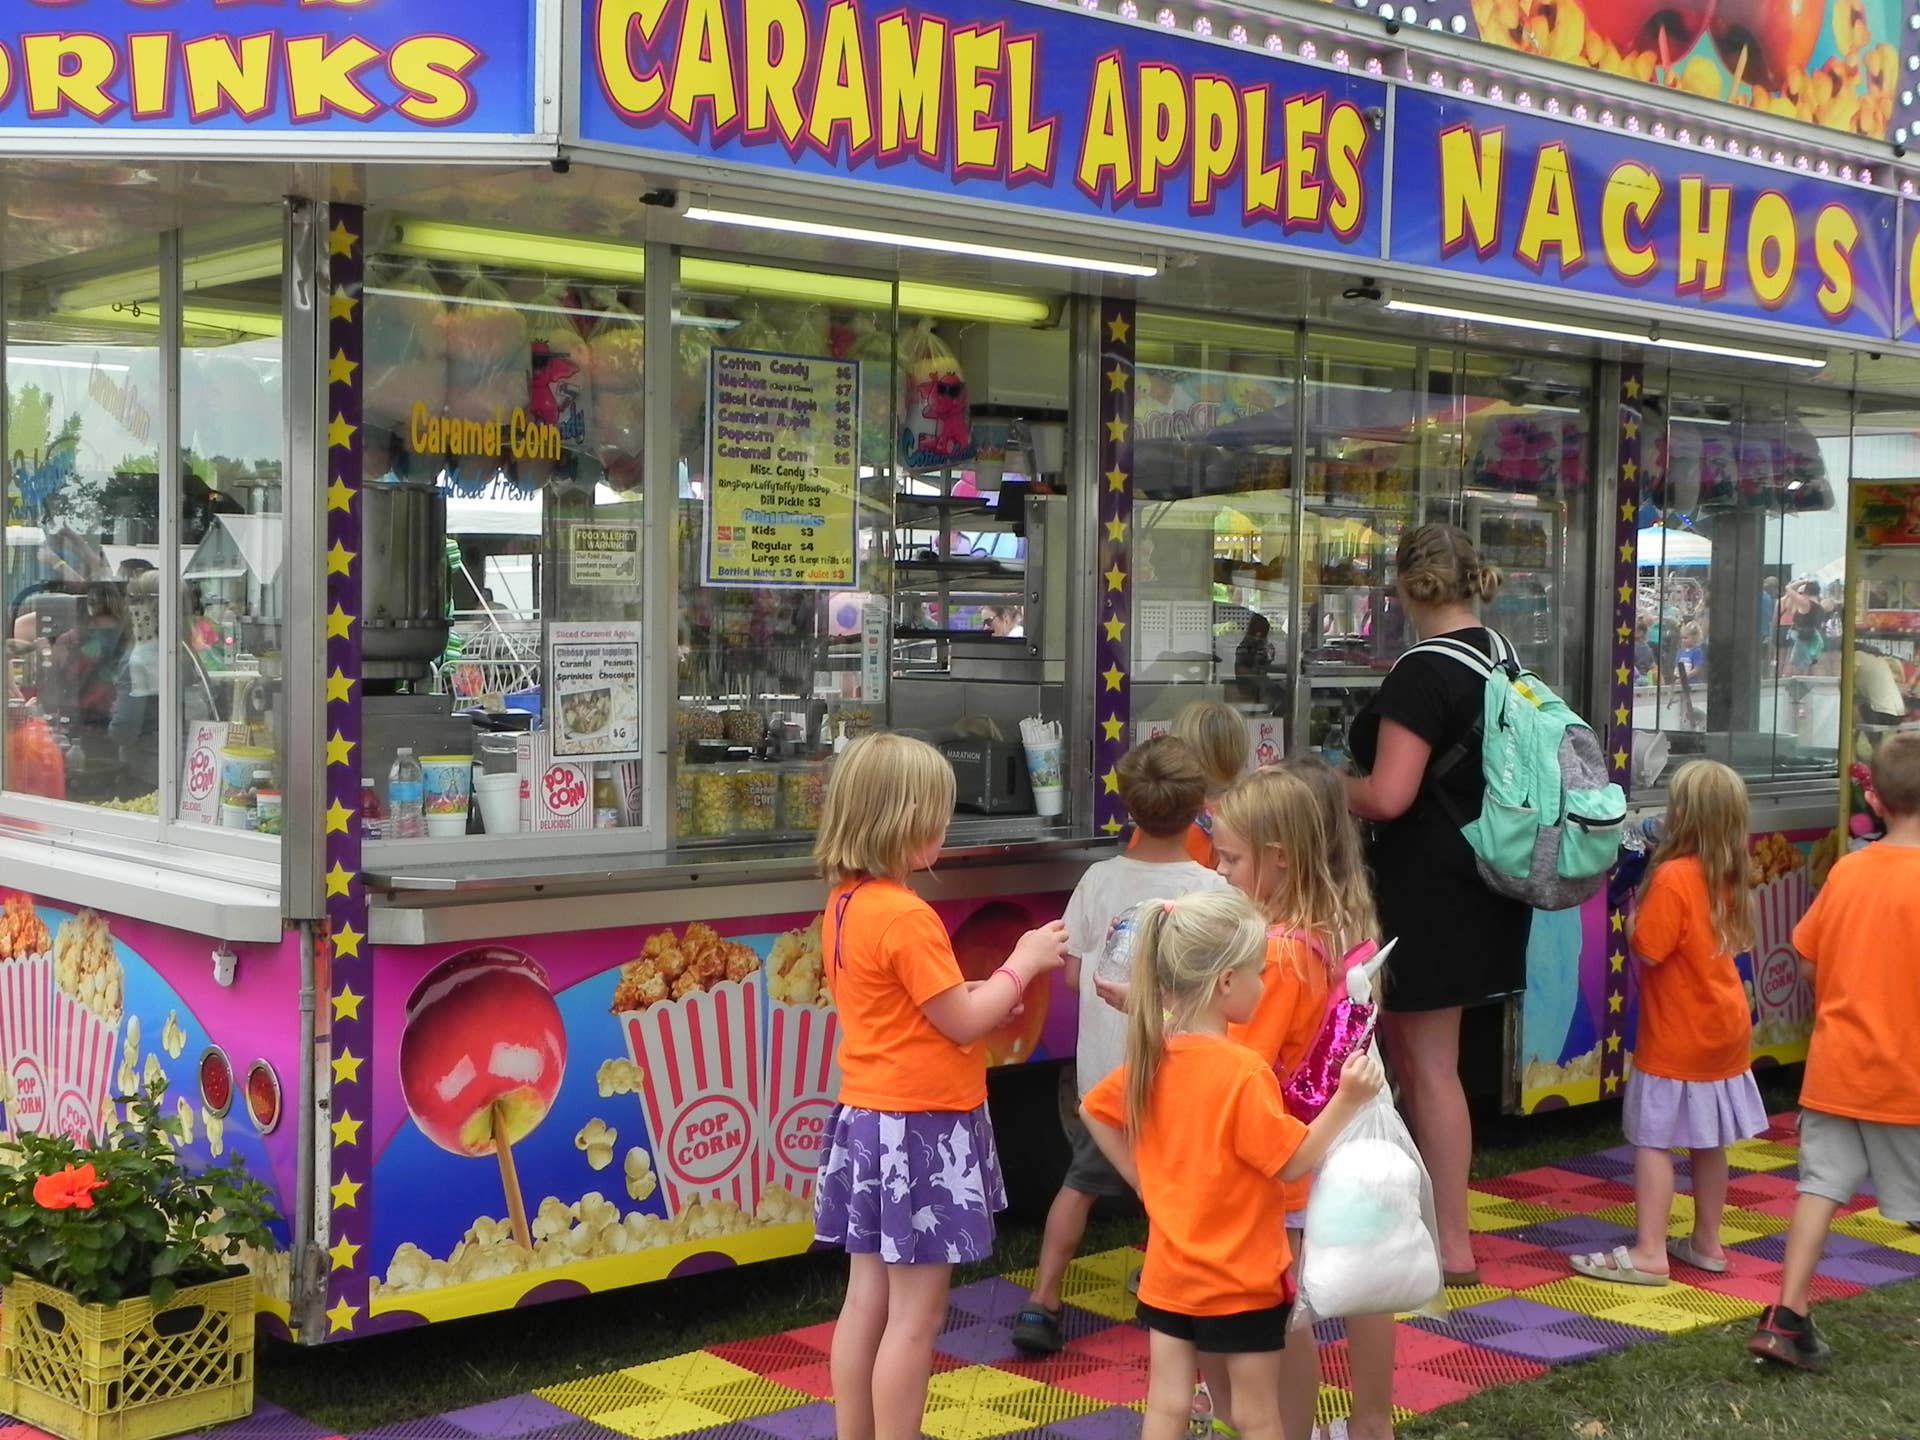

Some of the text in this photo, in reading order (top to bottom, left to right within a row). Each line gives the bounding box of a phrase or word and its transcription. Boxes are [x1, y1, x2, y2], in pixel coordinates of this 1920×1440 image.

[0, 31, 479, 120] RINKS
[596, 0, 1368, 236] CARAMEL APPLES
[1439, 121, 1859, 320] NACHOS
[719, 355, 761, 372] Cotton
[770, 359, 809, 381] Candy
[718, 373, 767, 391] Nachos
[718, 407, 769, 424] Caramel
[411, 401, 561, 460] Caramel Corn
[718, 425, 775, 444] Popcorn
[717, 443, 772, 460] Caramel
[776, 447, 809, 463] Corn
[776, 465, 806, 479] Candy
[760, 494, 821, 508] Dill Pickle $3
[577, 531, 635, 541] FOOD ALLERGY
[751, 525, 814, 537] Kids $3
[586, 541, 625, 550] WARNING
[751, 541, 814, 553] Regular $4
[751, 554, 780, 566] Large
[783, 554, 796, 564] $6
[718, 566, 750, 577] Bottled
[753, 567, 777, 577] Water
[795, 570, 805, 578] or
[807, 570, 830, 579] Juice
[832, 570, 846, 579] $3
[556, 630, 579, 639] Sliced
[580, 630, 612, 639] Caramel
[559, 659, 592, 668] Caramel
[556, 671, 635, 682] Sprinkles Chocolate
[613, 727, 627, 738] $6
[191, 750, 210, 775] POP
[946, 750, 981, 761] MARATHON
[190, 766, 215, 792] CORN
[544, 767, 574, 792] POP
[549, 781, 586, 810] CORN
[540, 819, 572, 830] DELICIOUS
[1768, 959, 1789, 979] POP
[1764, 972, 1794, 994] CORN
[17, 1077, 36, 1095] POP
[66, 1104, 87, 1129] POP
[796, 1116, 826, 1133] PO
[686, 1112, 729, 1144] POP
[678, 1129, 741, 1165] CORN
[783, 1133, 824, 1151] COR
